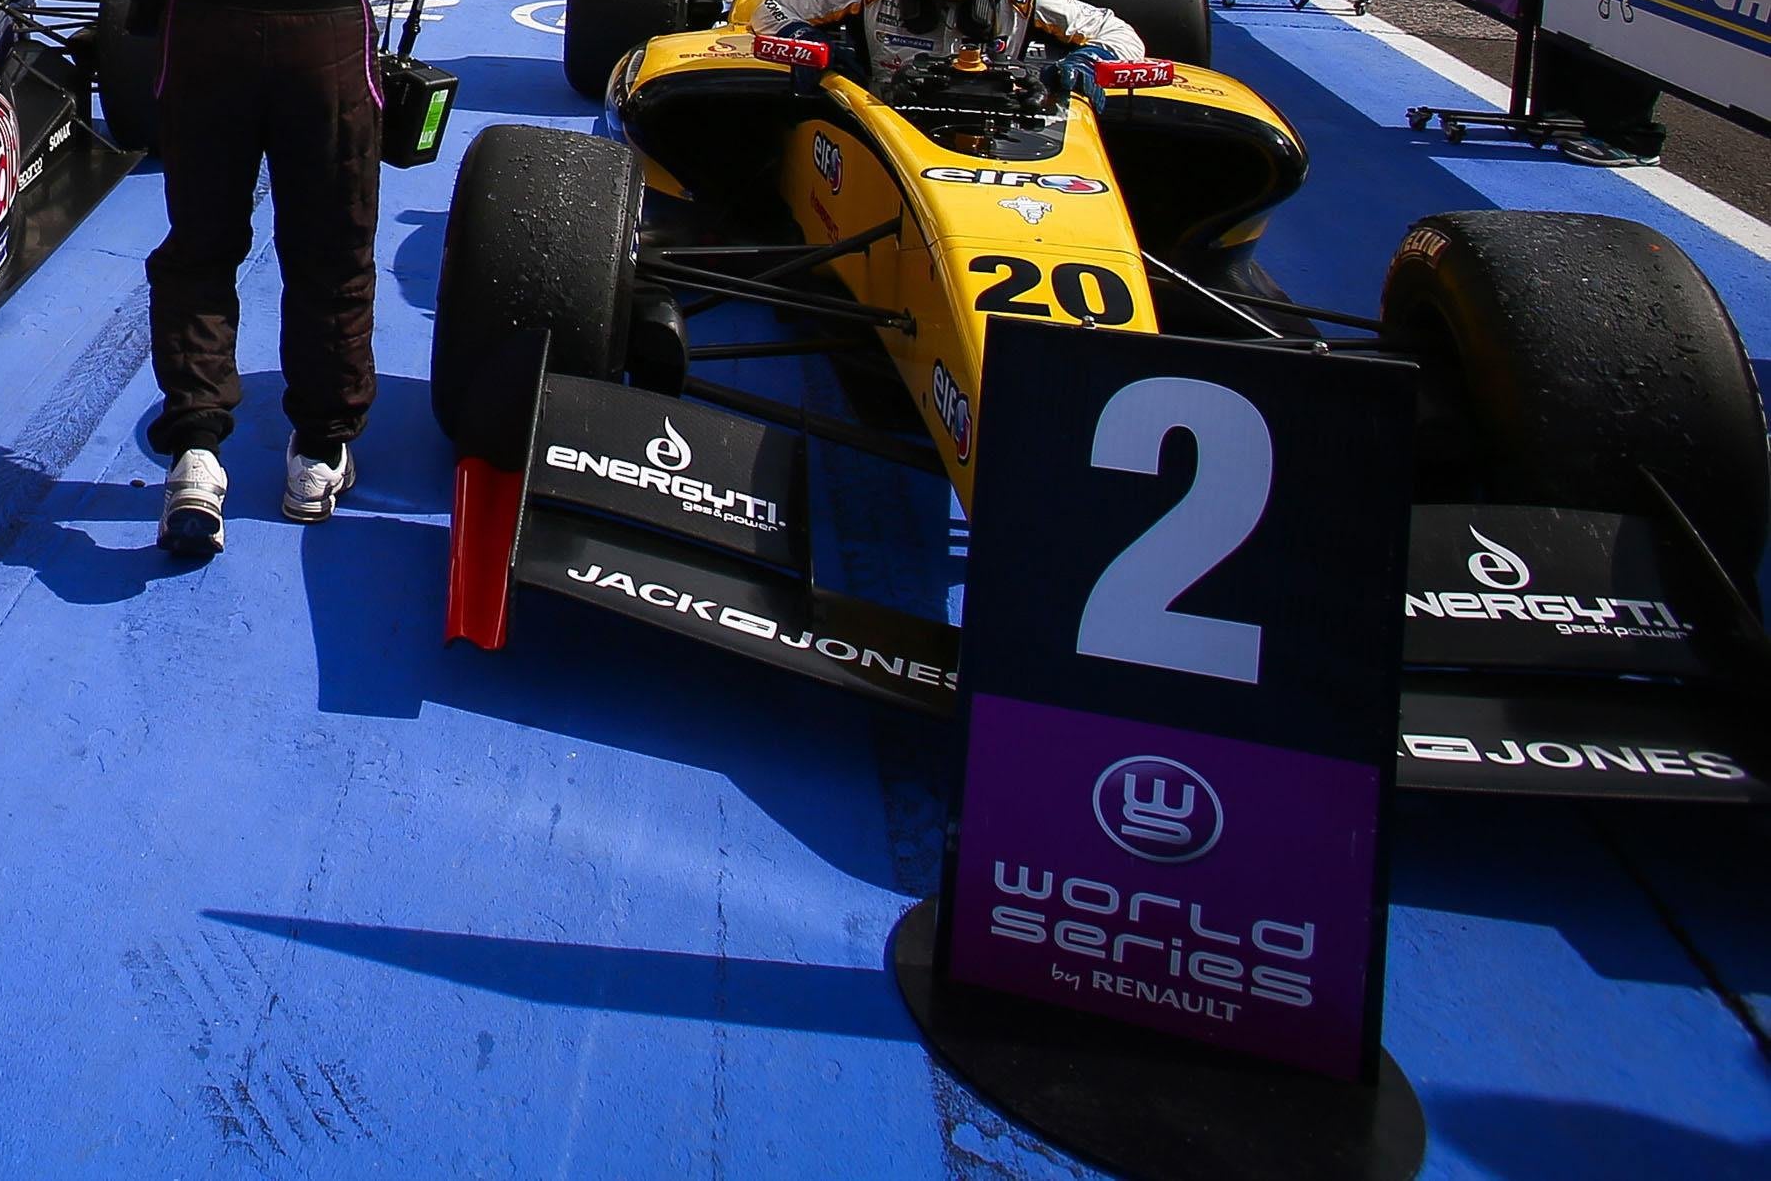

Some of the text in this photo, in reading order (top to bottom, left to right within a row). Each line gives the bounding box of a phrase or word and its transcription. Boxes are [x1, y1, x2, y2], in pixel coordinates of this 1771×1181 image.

[760, 41, 813, 61] B.R.M
[1114, 68, 1168, 84] B.R.M
[48, 121, 73, 152] SONAX
[17, 156, 43, 189] sparco
[925, 168, 1040, 186] elf
[967, 254, 1135, 326] 20
[1076, 375, 1274, 685] 2
[566, 564, 957, 692] JACK JONES
[1485, 739, 1747, 780] JONES
[993, 860, 1316, 961] world
[990, 904, 1314, 1008] series
[1050, 961, 1242, 1023] by RENAULT
